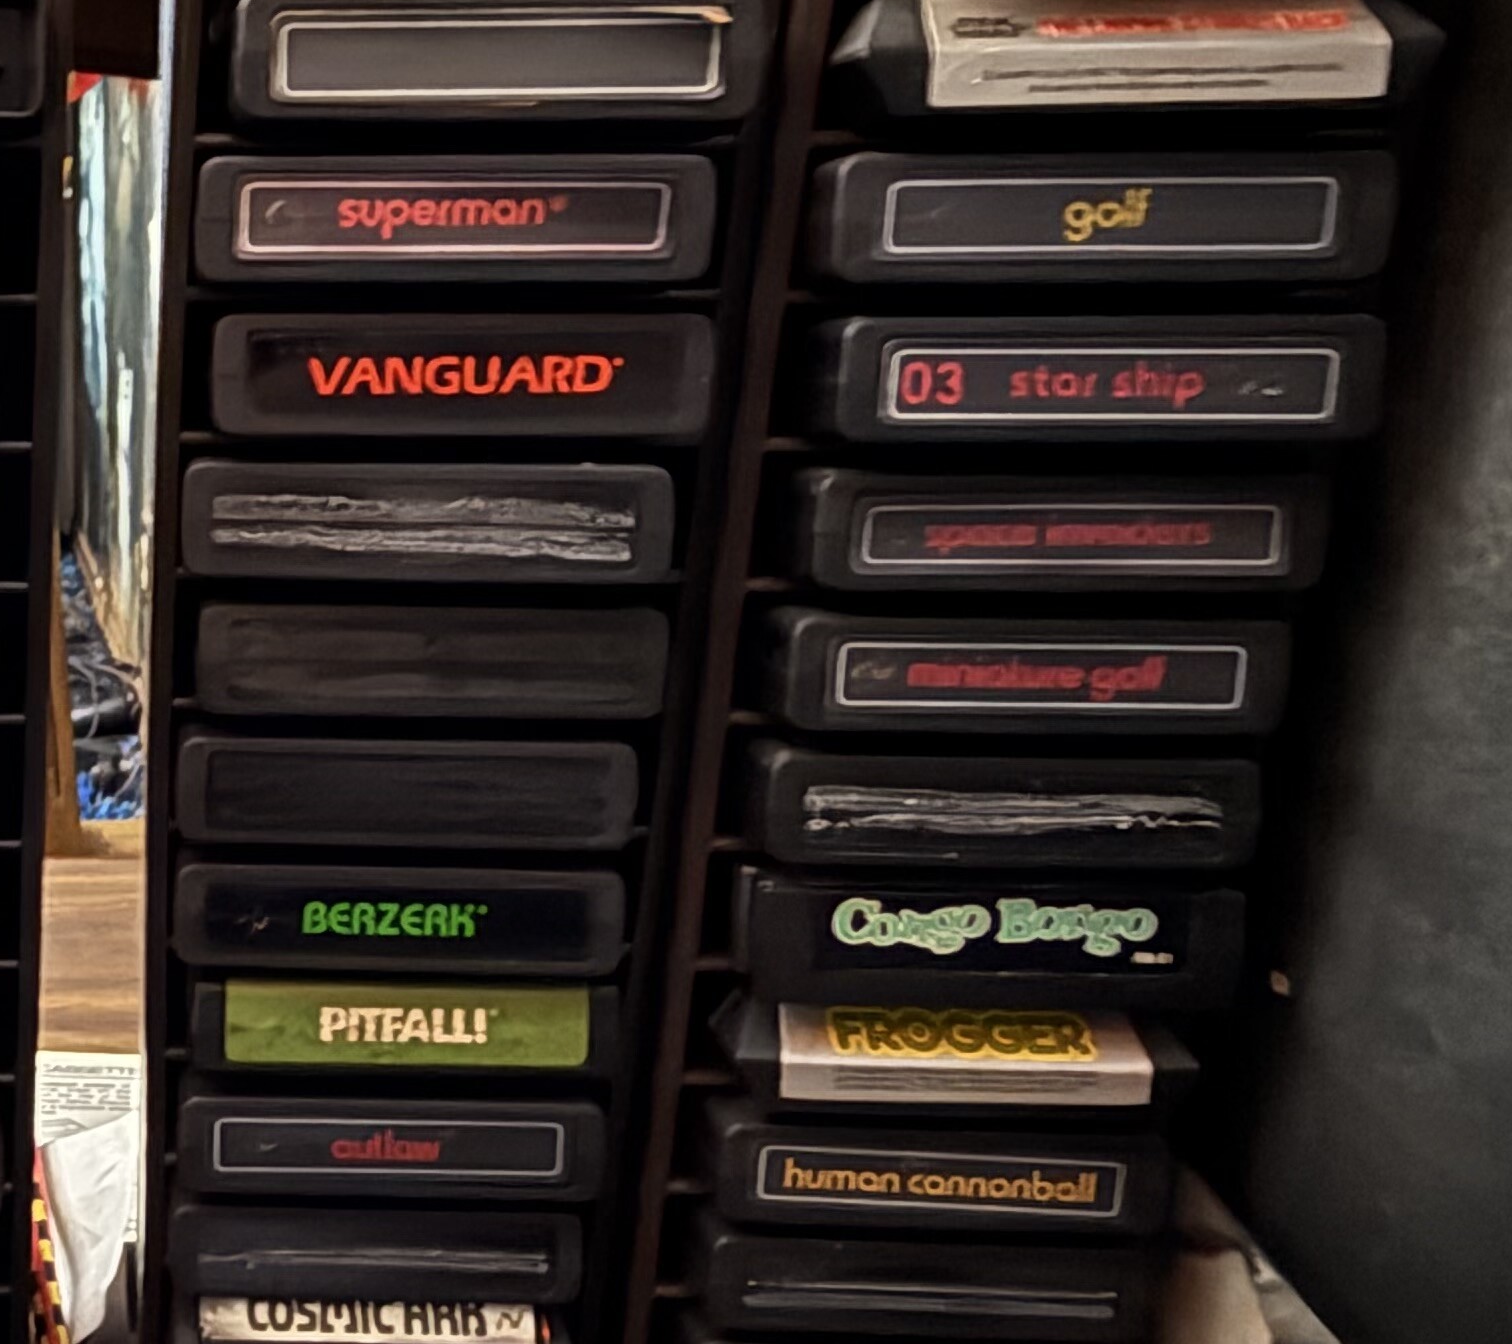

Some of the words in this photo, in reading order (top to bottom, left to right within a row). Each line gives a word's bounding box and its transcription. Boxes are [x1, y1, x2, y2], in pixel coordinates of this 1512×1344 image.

[338, 198, 547, 239] superman
[1063, 188, 1152, 242] golf
[307, 355, 614, 395] VANGUARD
[901, 361, 965, 405] 03
[1110, 361, 1206, 407] ship
[302, 901, 476, 937] BERZERK
[319, 1006, 487, 1044] PITFALL!
[831, 1008, 1091, 1056] FROGGER
[783, 1158, 900, 1193] human
[907, 1169, 1097, 1204] cannonball
[247, 1301, 394, 1333] COSMIC
